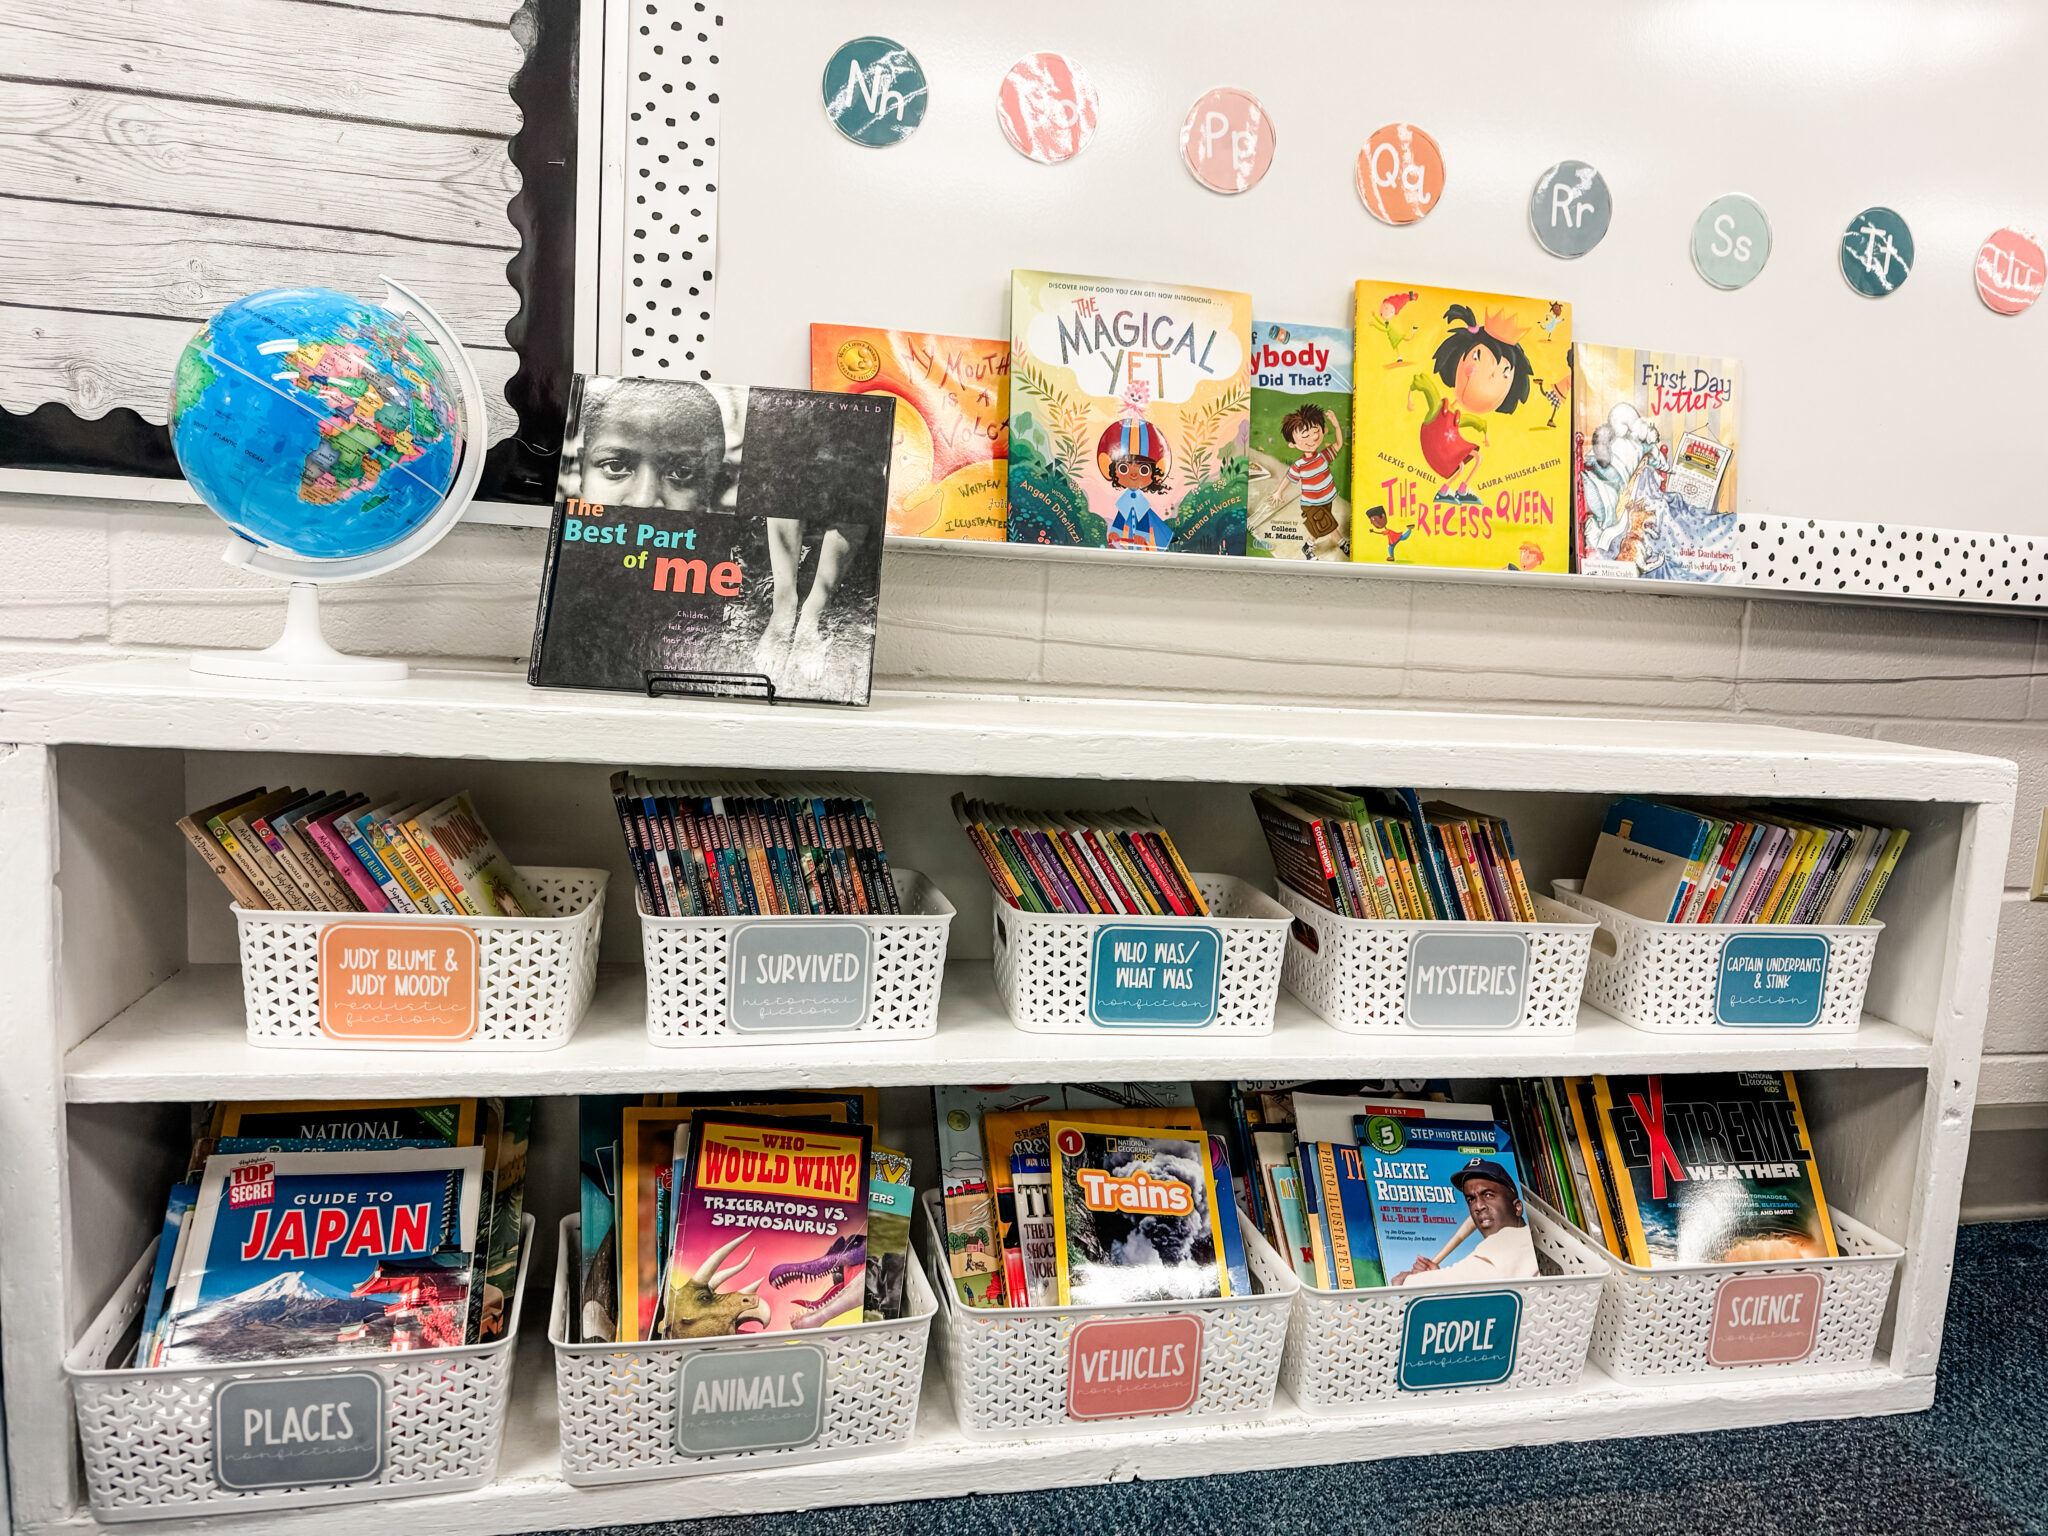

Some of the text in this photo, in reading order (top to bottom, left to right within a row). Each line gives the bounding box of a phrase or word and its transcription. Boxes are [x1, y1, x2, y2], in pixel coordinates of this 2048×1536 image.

[844, 59, 905, 121] Nn
[1204, 111, 1257, 171] Pp
[1371, 142, 1431, 204] Qq
[1551, 183, 1595, 229] Rr
[1711, 214, 1752, 262] Ss
[1860, 226, 1897, 275] Tt
[1048, 282, 1078, 291] DISCOVER
[1079, 285, 1094, 293] HOW
[1096, 286, 1115, 294] GOOD
[1116, 288, 1129, 296] YOU
[1130, 289, 1143, 297] CAN
[1158, 292, 1173, 300] NOW
[1072, 297, 1099, 318] THE
[1057, 310, 1217, 375] MAGICAL
[1100, 349, 1171, 399] YET
[1259, 373, 1332, 387] Did That?
[1642, 364, 1732, 401] First Day
[828, 402, 882, 413] EWALD
[976, 388, 991, 408] A
[1651, 385, 1724, 416] Jitters
[1377, 452, 1437, 485] ALEXIS O'NEILL
[1477, 457, 1561, 491] LAURA HULISKA-BEITH
[566, 498, 604, 517] The
[1381, 477, 1417, 518] THE
[1496, 489, 1554, 525] QUEEN
[1019, 480, 1051, 505] Angela
[1051, 502, 1083, 544] DiTerlizzi
[1184, 495, 1242, 541] Lorena Alvarez
[1417, 503, 1493, 540] RECESS
[564, 519, 697, 551] Best Part
[1271, 525, 1297, 533] Colleen
[1275, 533, 1304, 541] Madden
[1680, 547, 1696, 557] Julie
[623, 551, 743, 597] of me
[1719, 563, 1737, 573] Love
[677, 610, 709, 620] Children
[1314, 825, 1333, 874] GOOSEBUMPS
[355, 844, 385, 882] JUDY BLUME
[386, 851, 423, 896] JUDY BLUME
[401, 848, 417, 867] JUDY
[414, 863, 438, 893] BLUME
[429, 850, 446, 866] JUDY
[441, 864, 459, 892] BLUME
[339, 948, 459, 972] JUDY BLUME &
[1114, 940, 1200, 964] WHO WAS/
[740, 953, 860, 985] I SURVIVED
[1727, 956, 1822, 973] CAPTAIN UNDERPANTS
[347, 975, 451, 997] JUDY MOODY
[1116, 968, 1193, 990] WHAT WAS
[1416, 964, 1517, 996] MYSTERIES
[1753, 973, 1792, 989] & STINK
[334, 1000, 466, 1012] realistic
[742, 996, 857, 1006] historical
[759, 1007, 840, 1019] fiction
[1097, 999, 1209, 1010] nonfiction
[1729, 995, 1808, 1008] fiction
[346, 1013, 453, 1027] fiction
[300, 1120, 404, 1140] NATIONAL
[1381, 1126, 1395, 1145] 5
[1410, 1128, 1496, 1142] STEP INTO READING
[1608, 1075, 1812, 1200] EXTREME
[762, 1133, 805, 1152] WHO
[1065, 1135, 1074, 1151] 1
[1117, 1138, 1148, 1147] NATIONAL
[231, 1163, 274, 1184] TOP
[705, 1139, 857, 1197] WOULD WIN?
[1373, 1158, 1430, 1180] JACKIE
[1685, 1163, 1801, 1182] WEATHER
[231, 1180, 274, 1204] SECRET
[294, 1191, 393, 1205] GUIDE TO
[1083, 1175, 1189, 1211] Trains
[1374, 1180, 1456, 1204] ROBINSON
[703, 1196, 849, 1221] TRICERATOPS VS.
[1320, 1149, 1351, 1272] PHOTO-ILLUSTRATED
[1381, 1213, 1457, 1224] ALL-BLACK BASEBALL
[241, 1203, 432, 1262] JAPAN
[711, 1212, 838, 1236] SPINOSAURUS
[1023, 1223, 1046, 1240] THE
[1728, 1293, 1804, 1328] SCIENCE
[1421, 1318, 1497, 1355] PEOPLE
[1081, 1343, 1185, 1383] VEHICLES
[1405, 1354, 1506, 1368] nonfiction
[691, 1371, 805, 1415] ANIMALS
[1076, 1381, 1190, 1396] nonfiction
[244, 1401, 354, 1447] PLACES
[685, 1411, 813, 1429] nonfiction
[224, 1444, 375, 1462] nonfiction
